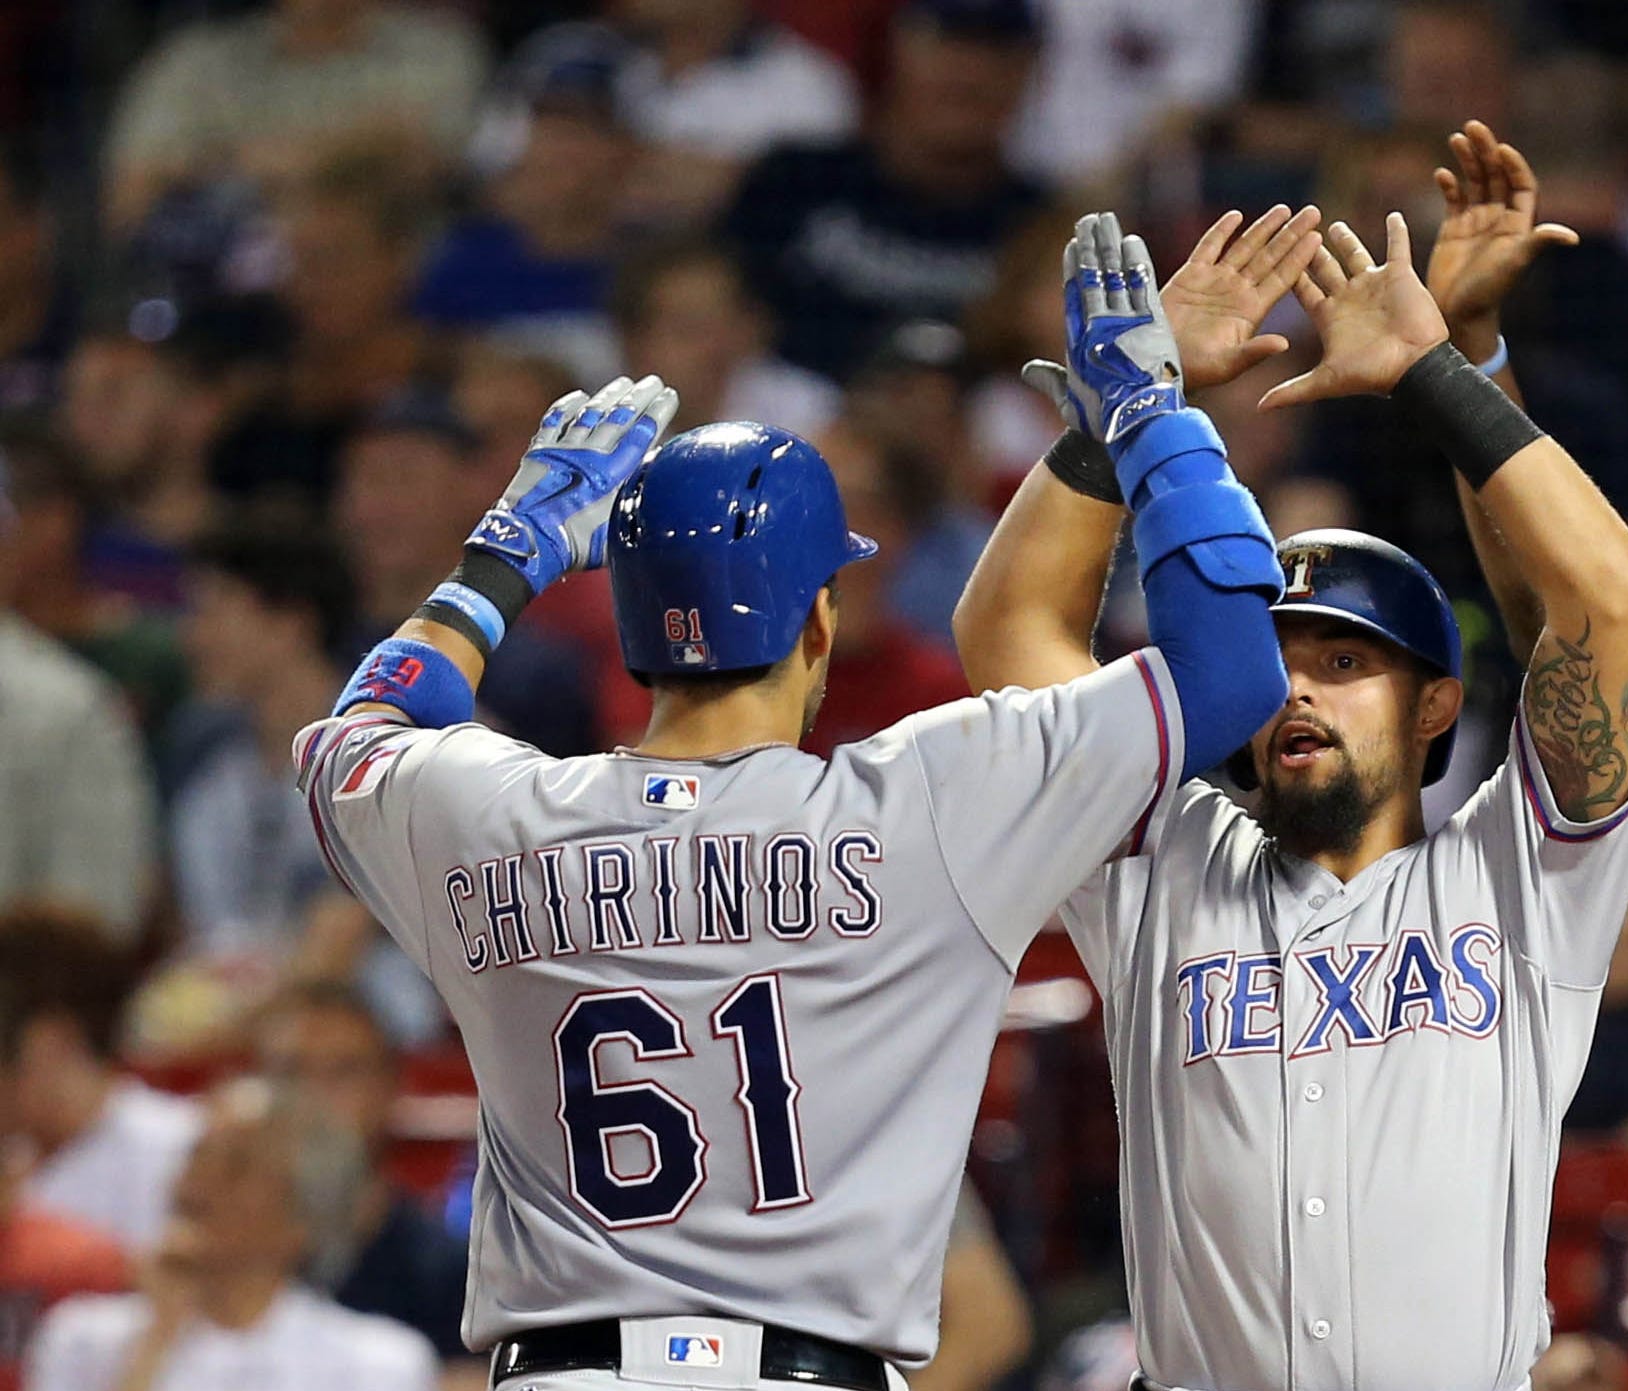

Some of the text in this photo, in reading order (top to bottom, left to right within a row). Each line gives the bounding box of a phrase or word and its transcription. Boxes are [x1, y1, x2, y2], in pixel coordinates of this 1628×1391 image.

[664, 608, 703, 641] 61
[1281, 545, 1332, 598] T
[444, 830, 883, 974] CHIRINOS
[1176, 922, 1503, 1067] TEXAS
[552, 972, 815, 1231] 61
